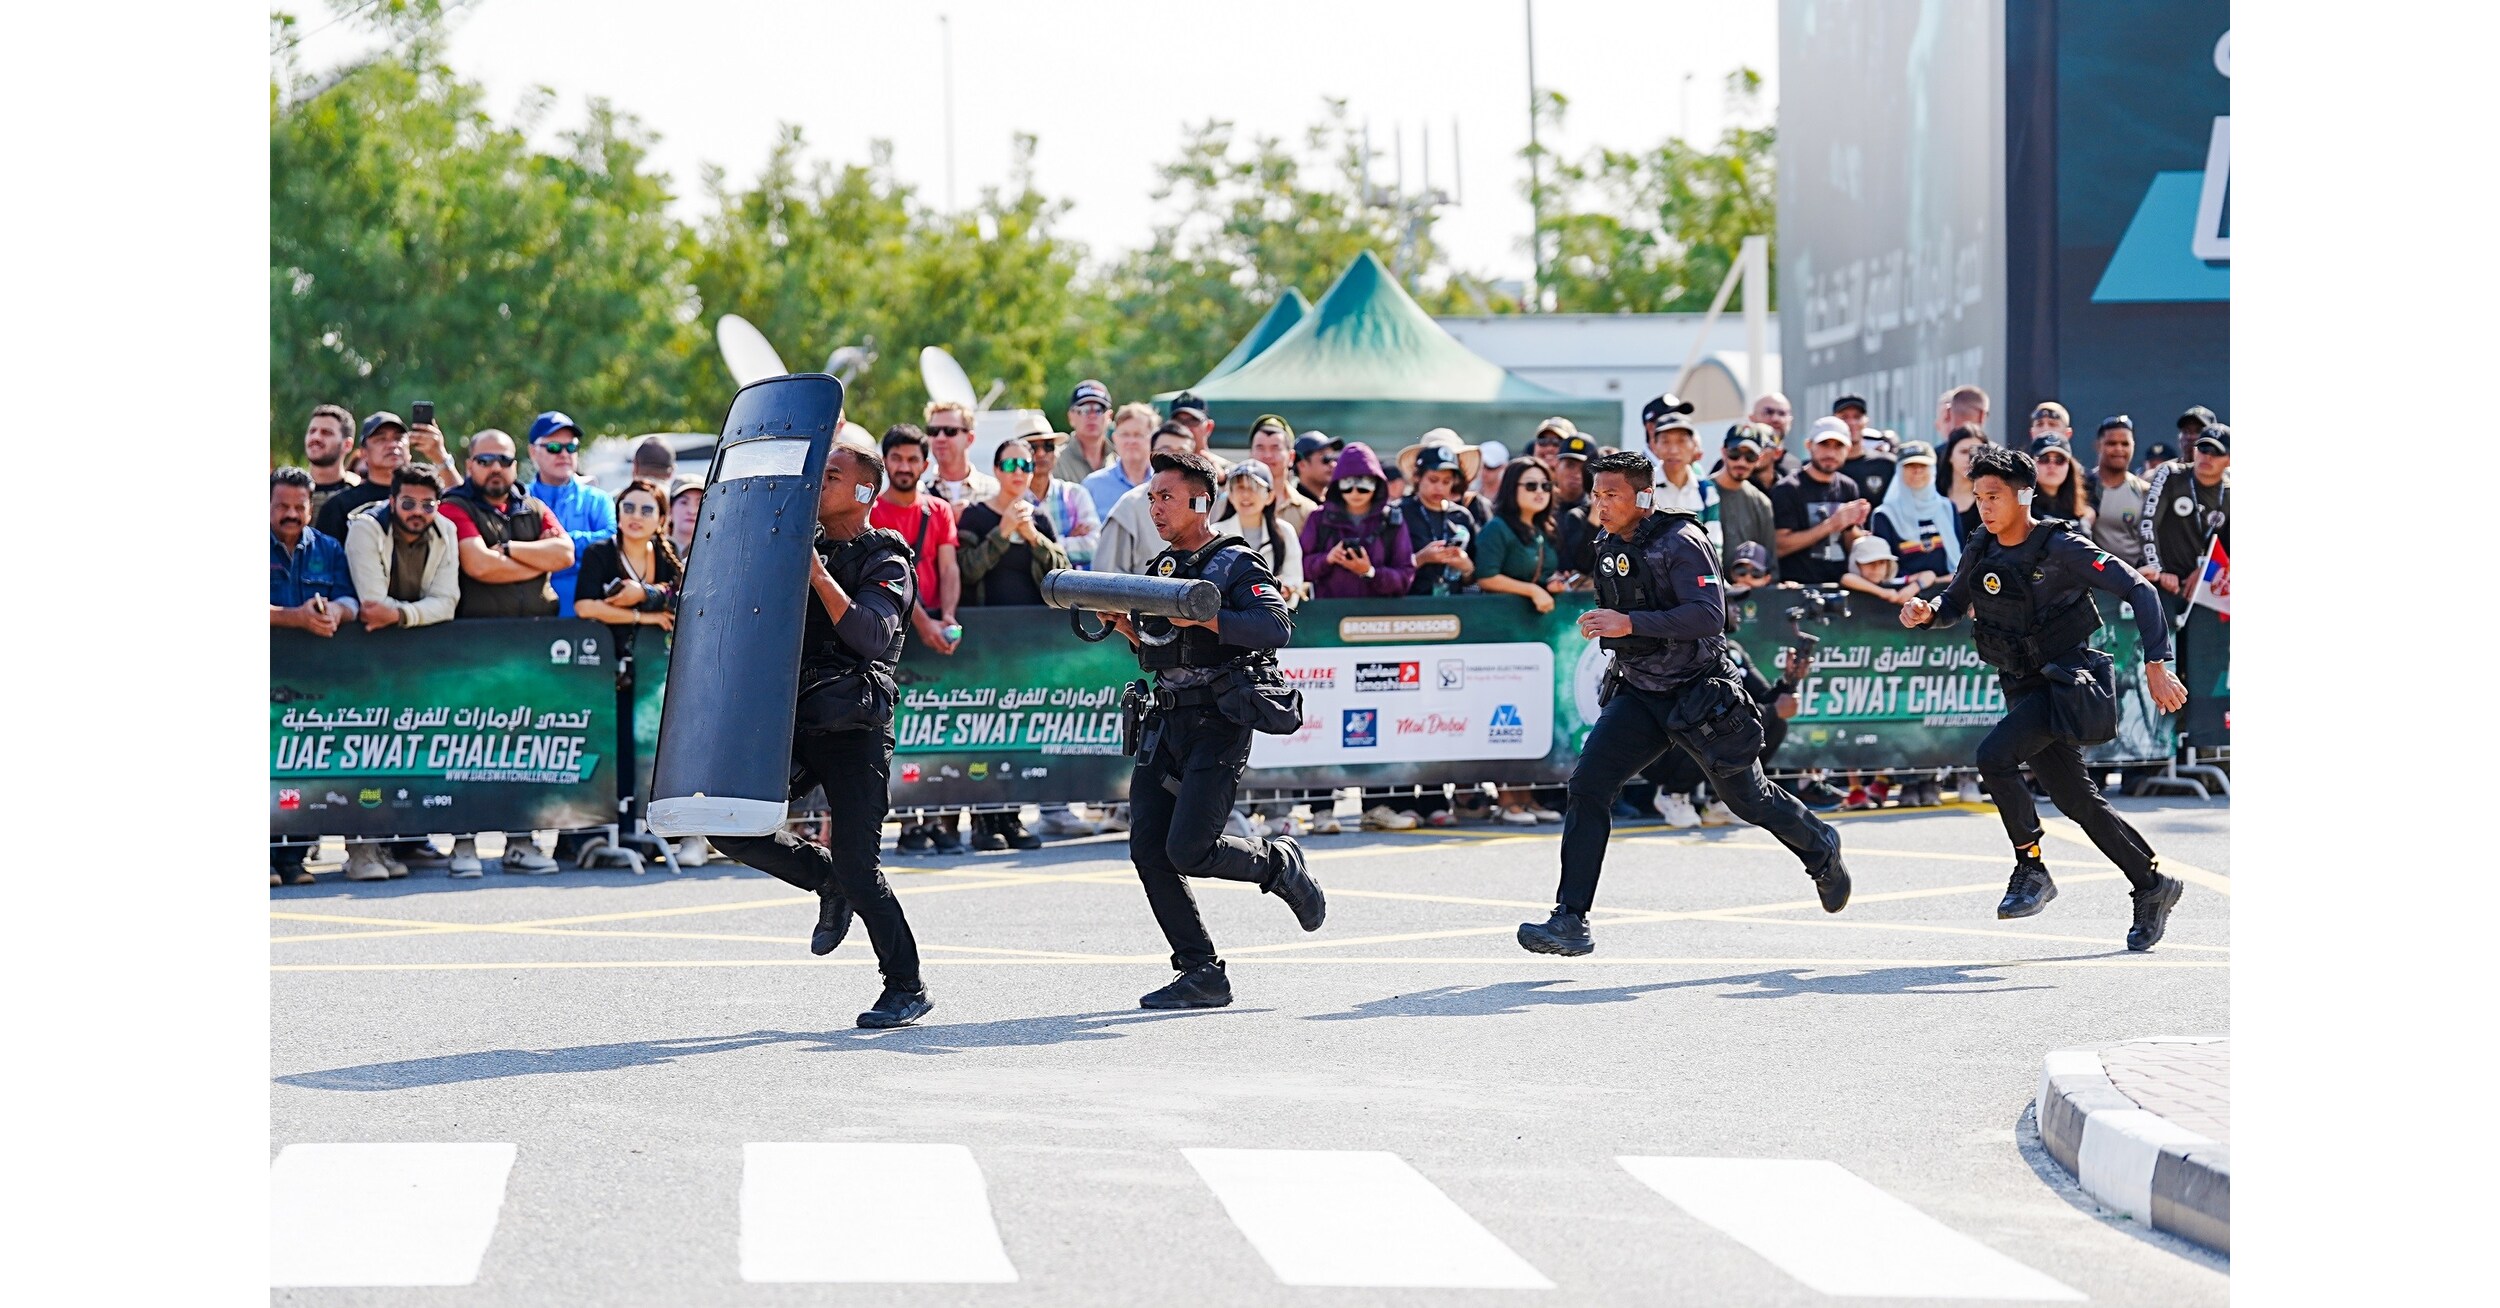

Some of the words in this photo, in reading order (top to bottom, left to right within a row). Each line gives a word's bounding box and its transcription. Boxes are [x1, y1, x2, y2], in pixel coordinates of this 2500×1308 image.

[2140, 519, 2155, 542] OF
[1343, 621, 1391, 634] BRONZE
[1393, 619, 1457, 633] SPONSORS
[1873, 645, 1926, 673] للفرق
[1283, 667, 1337, 679] NUBE
[1286, 680, 1335, 689] ERTIES
[904, 688, 996, 711] التكتيكية
[998, 687, 1048, 710] للفرق
[1050, 686, 1115, 710] الإمارات
[1827, 676, 1902, 715] SWAT
[1907, 674, 2005, 714] CHALLE
[282, 707, 390, 732] التكتيكية
[393, 706, 450, 731] للفرق
[454, 705, 532, 731] الإمارات
[534, 709, 591, 730] تحدي
[900, 713, 949, 746] UAE
[952, 712, 1024, 745] SWAT
[1026, 712, 1123, 744] CHALLEN
[276, 735, 336, 770] UAE
[340, 734, 424, 769] SWAT
[427, 734, 586, 771] CHALLENGE
[279, 788, 300, 801] SPS
[434, 795, 452, 806] 901
